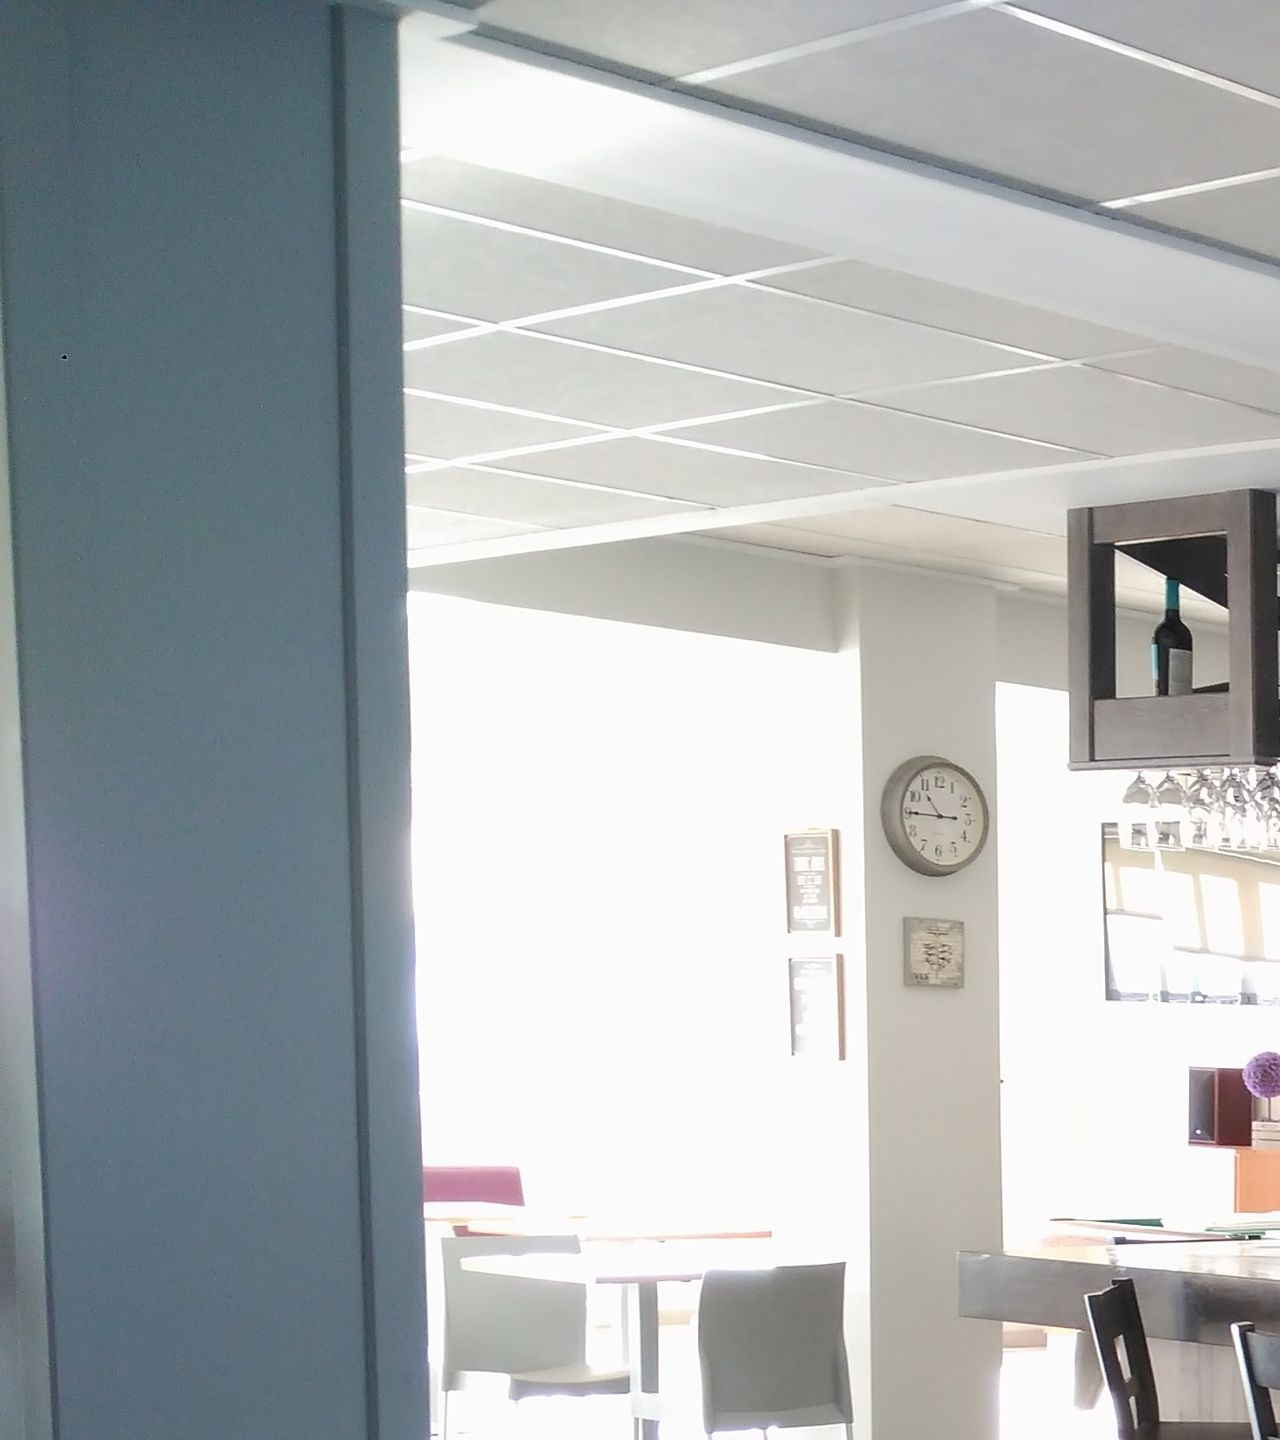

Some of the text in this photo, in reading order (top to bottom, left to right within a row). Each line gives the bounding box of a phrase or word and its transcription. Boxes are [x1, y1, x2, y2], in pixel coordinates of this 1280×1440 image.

[921, 778, 930, 791] 11
[934, 776, 945, 789] 12
[910, 790, 921, 803] 10
[960, 795, 968, 807] 2
[920, 839, 928, 852] 7
[934, 844, 942, 857] 6
